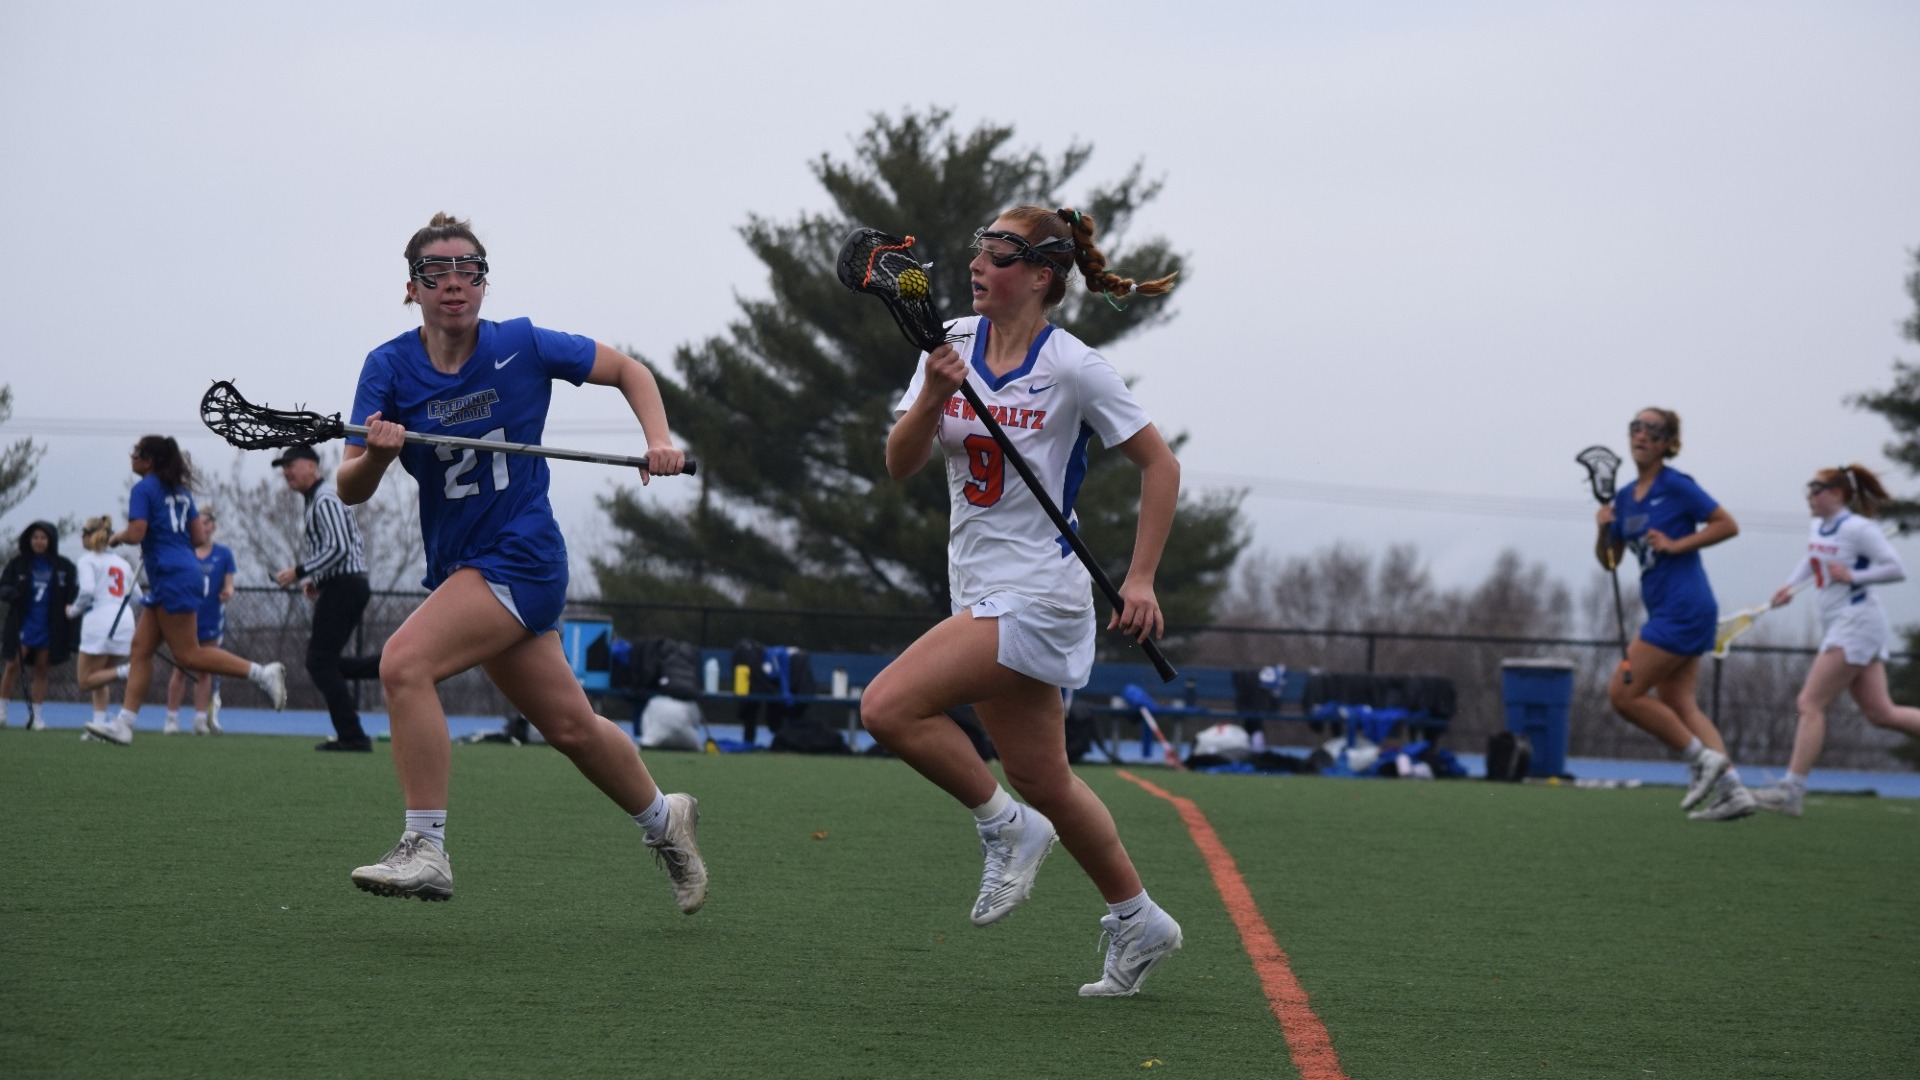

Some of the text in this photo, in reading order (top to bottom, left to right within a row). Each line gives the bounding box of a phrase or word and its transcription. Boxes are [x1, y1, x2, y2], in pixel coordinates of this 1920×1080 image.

[428, 388, 500, 419] FREDONIA
[440, 403, 492, 426] STATE
[435, 428, 510, 499] 21
[963, 433, 1005, 508] 9
[165, 495, 191, 533] 17
[34, 582, 48, 602] 7
[108, 566, 124, 597] 3
